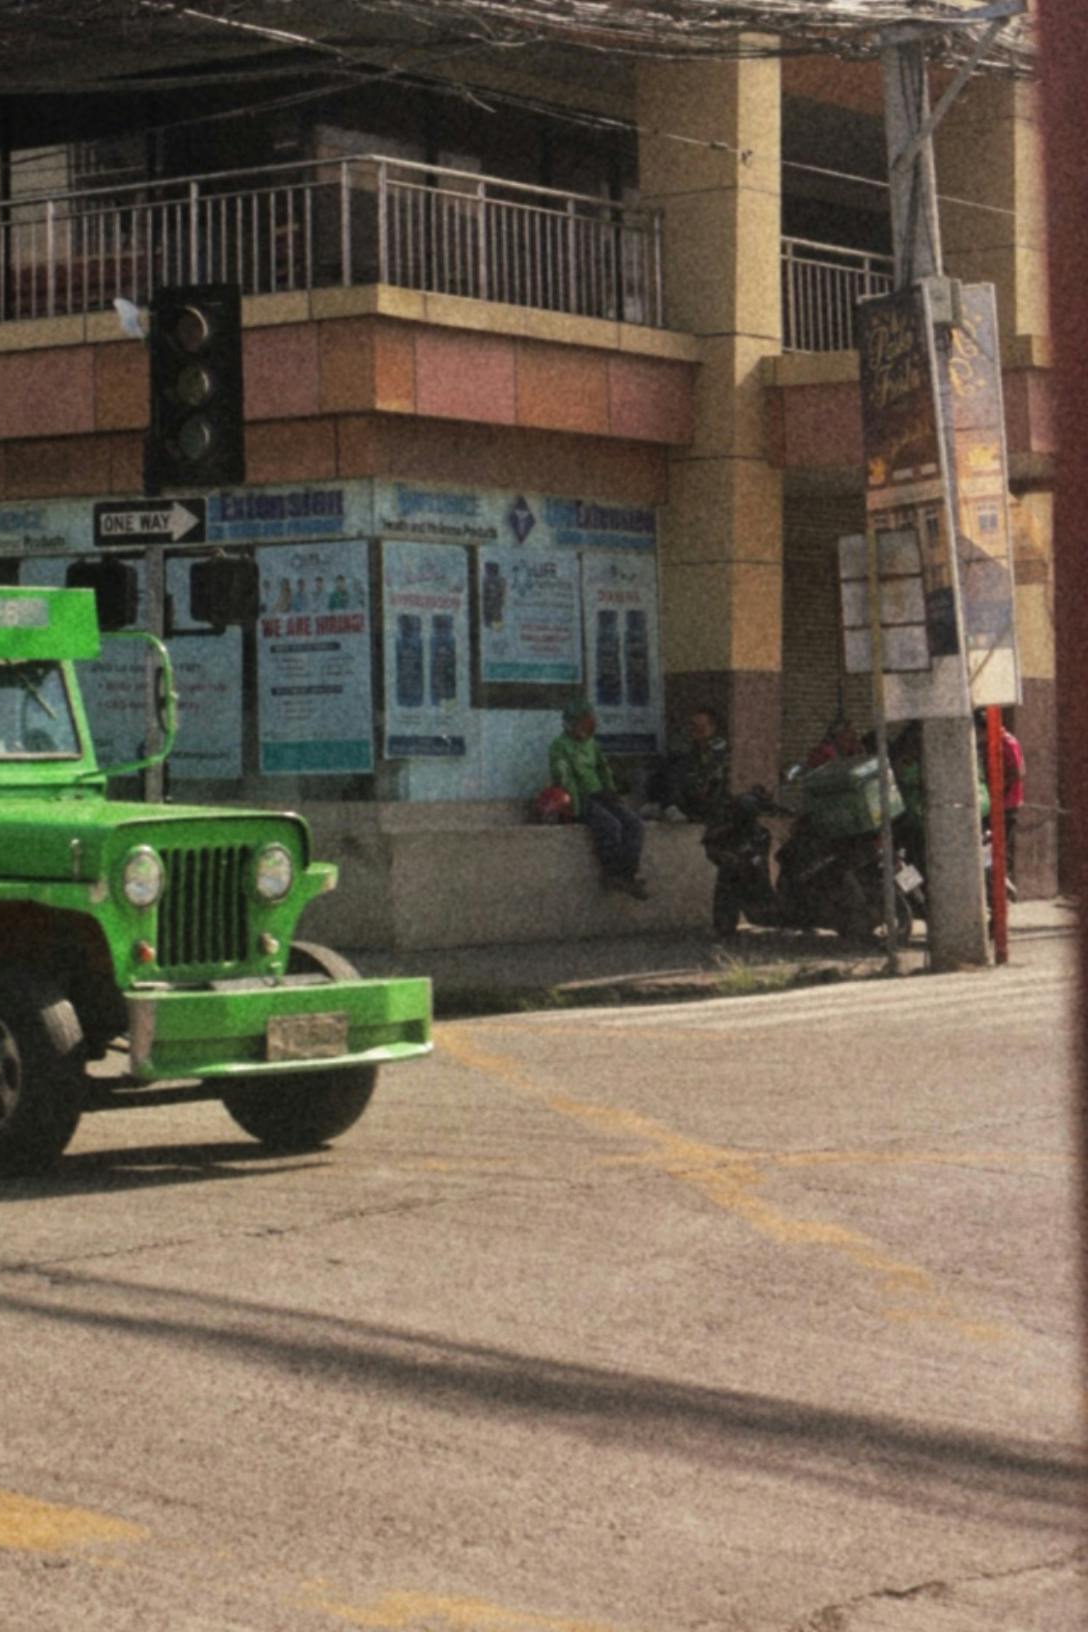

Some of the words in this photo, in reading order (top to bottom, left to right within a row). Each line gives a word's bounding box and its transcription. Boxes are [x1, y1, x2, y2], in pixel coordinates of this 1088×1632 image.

[102, 513, 137, 535] ONE
[139, 511, 171, 533] WAY
[262, 618, 281, 638] WE
[286, 616, 312, 636] ARE
